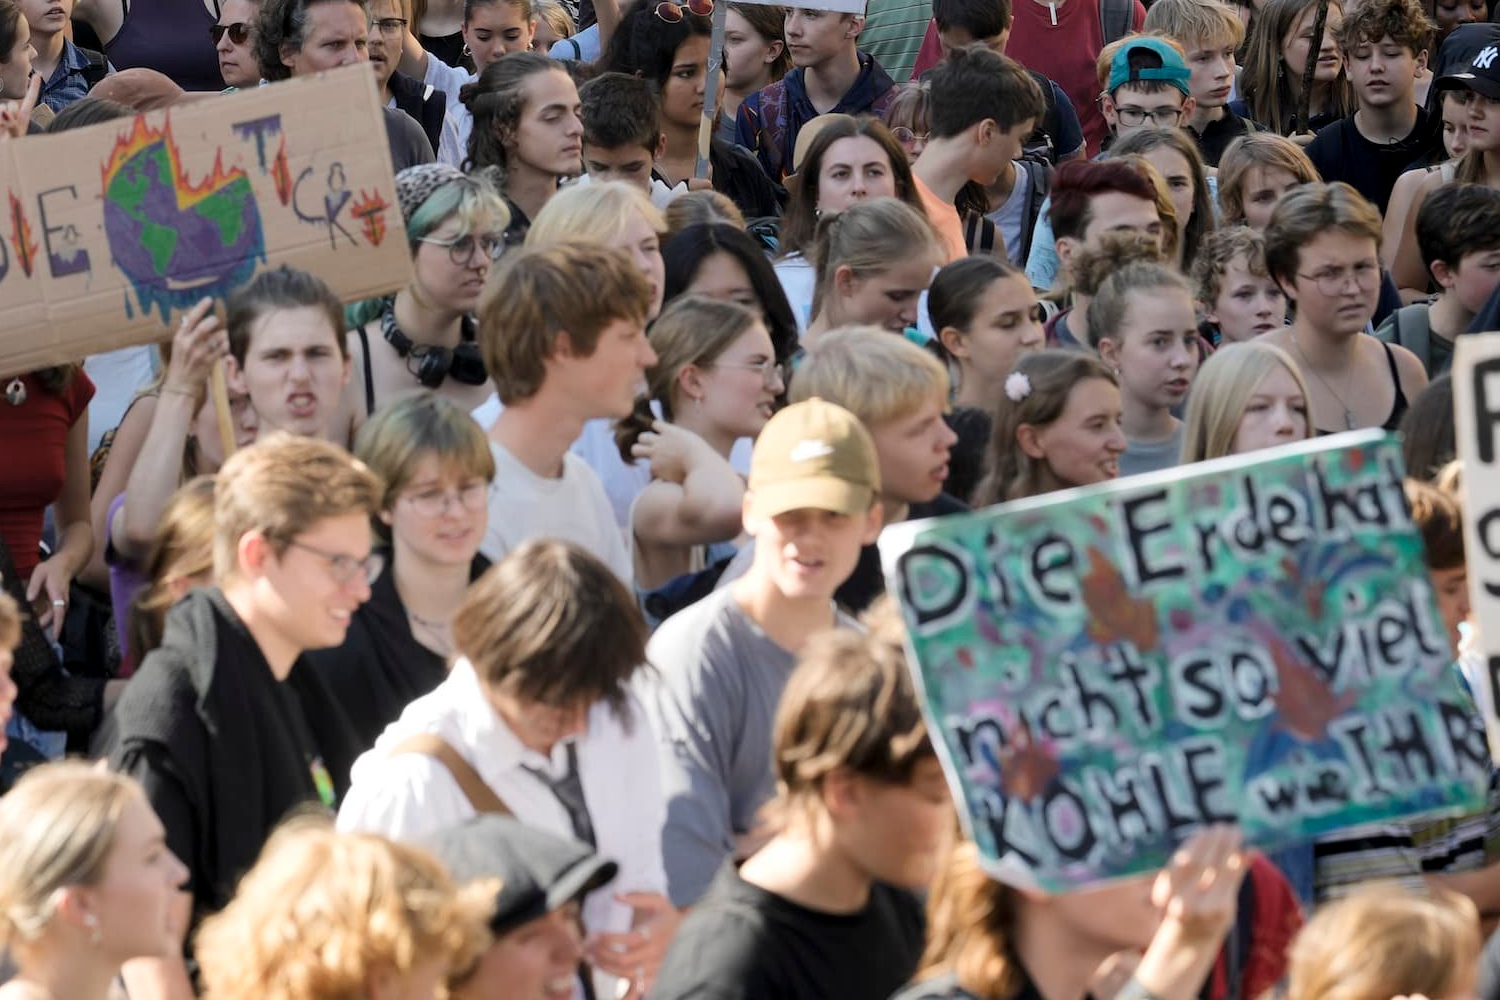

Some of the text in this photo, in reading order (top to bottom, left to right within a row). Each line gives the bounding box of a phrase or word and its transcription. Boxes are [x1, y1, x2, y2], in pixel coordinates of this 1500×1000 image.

[896, 447, 1414, 627] Die Erde hat
[955, 587, 1440, 765] nicht so viel
[985, 744, 1239, 868] KOHLE
[1344, 700, 1490, 799] IHR
